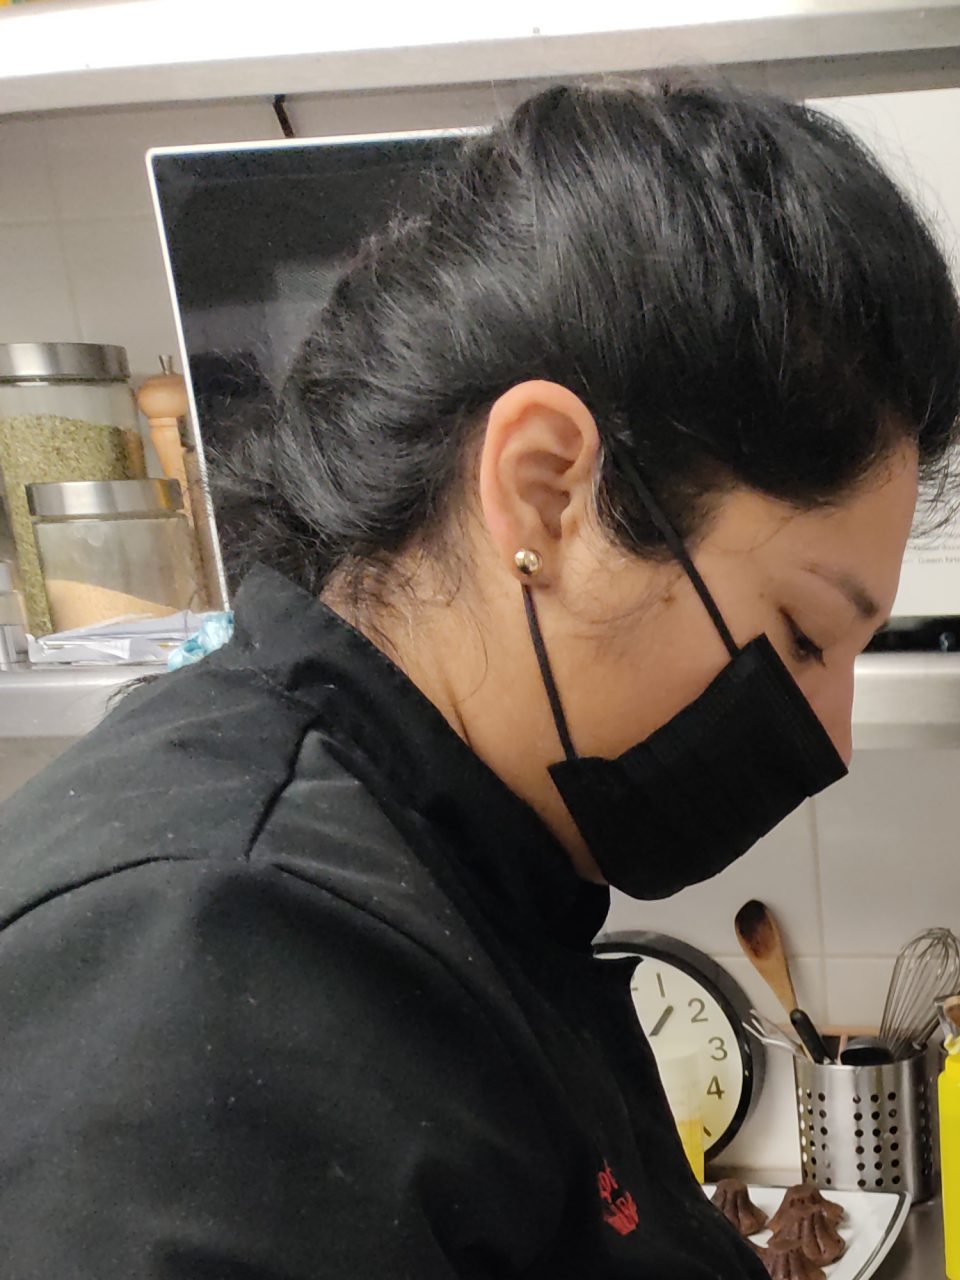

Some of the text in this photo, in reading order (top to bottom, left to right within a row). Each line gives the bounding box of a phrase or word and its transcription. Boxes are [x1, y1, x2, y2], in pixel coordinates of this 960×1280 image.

[687, 998, 709, 1024] 2
[708, 1037, 728, 1061] 3
[706, 1075, 725, 1100] 4
